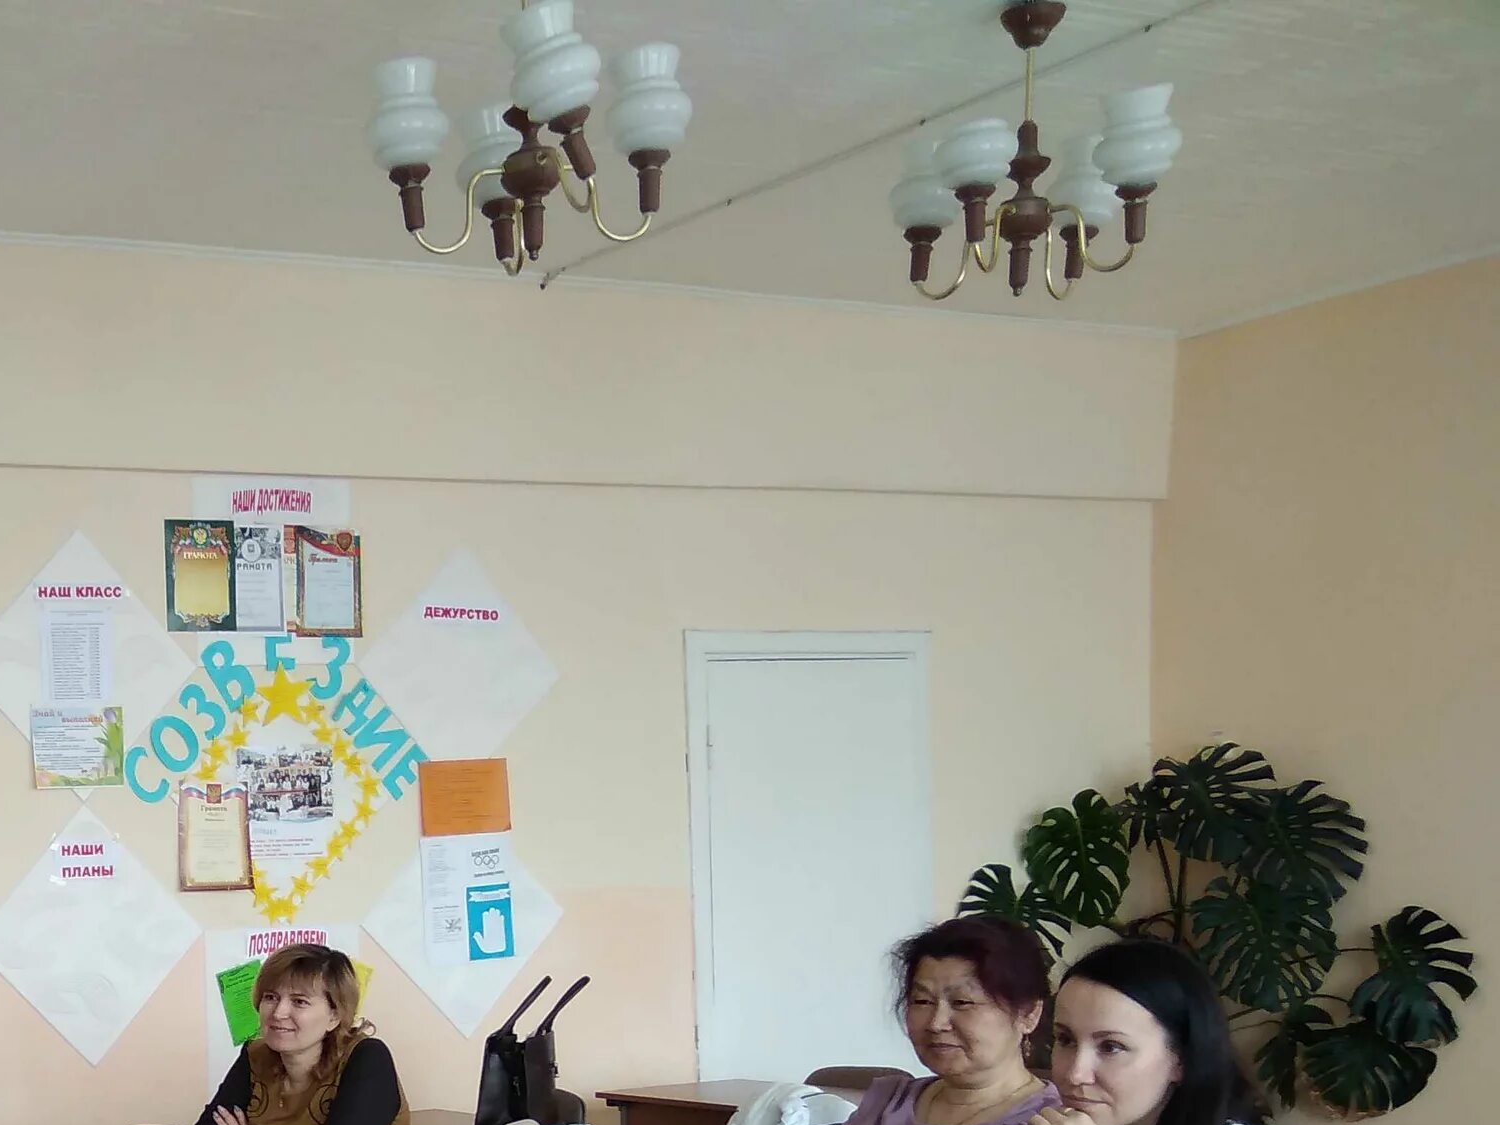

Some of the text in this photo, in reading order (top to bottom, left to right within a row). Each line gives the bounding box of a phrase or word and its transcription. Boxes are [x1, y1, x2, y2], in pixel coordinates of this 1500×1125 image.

[232, 489, 312, 516] НАШИ ДОСТИЖЕНИЯ
[236, 562, 272, 570] РАМОТА
[38, 586, 122, 598] НАШ КЛАСС
[424, 606, 499, 621] ДЕЖУРСТВО
[61, 844, 104, 856] НАШИ
[62, 865, 114, 878] ПЛАНЫ
